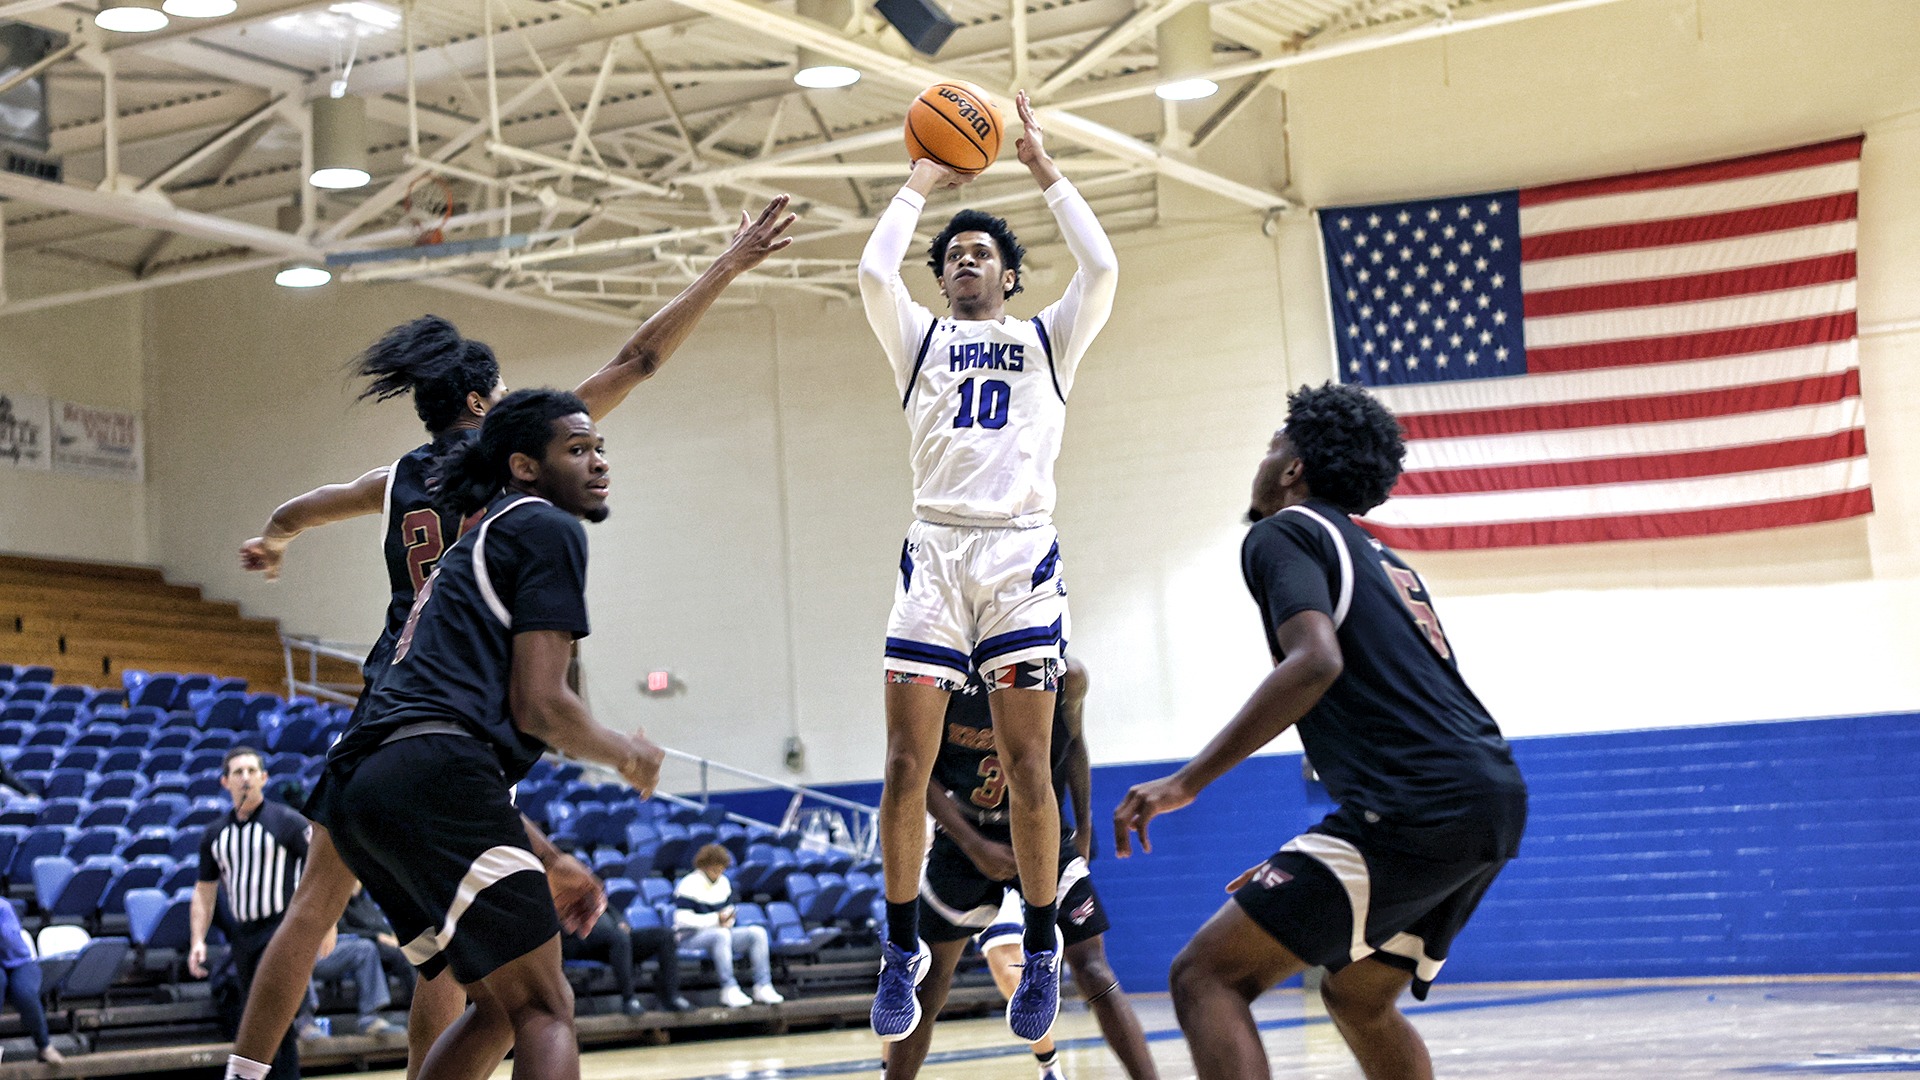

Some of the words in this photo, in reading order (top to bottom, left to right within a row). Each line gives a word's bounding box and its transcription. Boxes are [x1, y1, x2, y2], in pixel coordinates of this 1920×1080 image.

[938, 88, 991, 141] Wilson
[949, 341, 1025, 373] HAWKS
[952, 377, 1012, 430] 10
[969, 754, 1009, 810] 3
